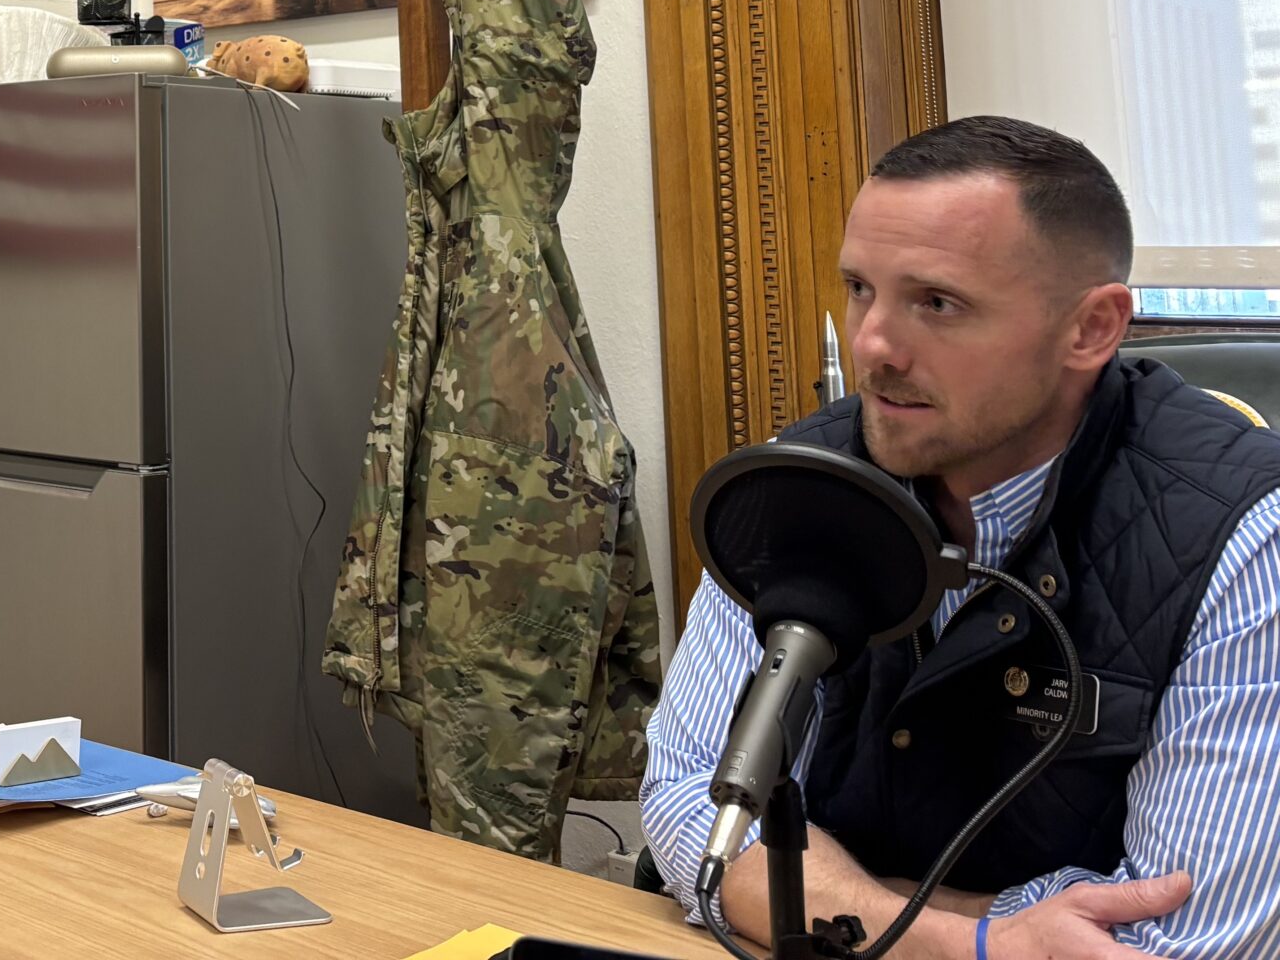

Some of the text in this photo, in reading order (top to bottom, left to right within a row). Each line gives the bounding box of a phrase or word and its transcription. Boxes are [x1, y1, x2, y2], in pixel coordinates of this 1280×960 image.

[185, 45, 200, 61] 2X
[1051, 678, 1069, 689] JARV
[1044, 687, 1069, 699] CALDW
[1016, 705, 1064, 722] MINORITY LEA
